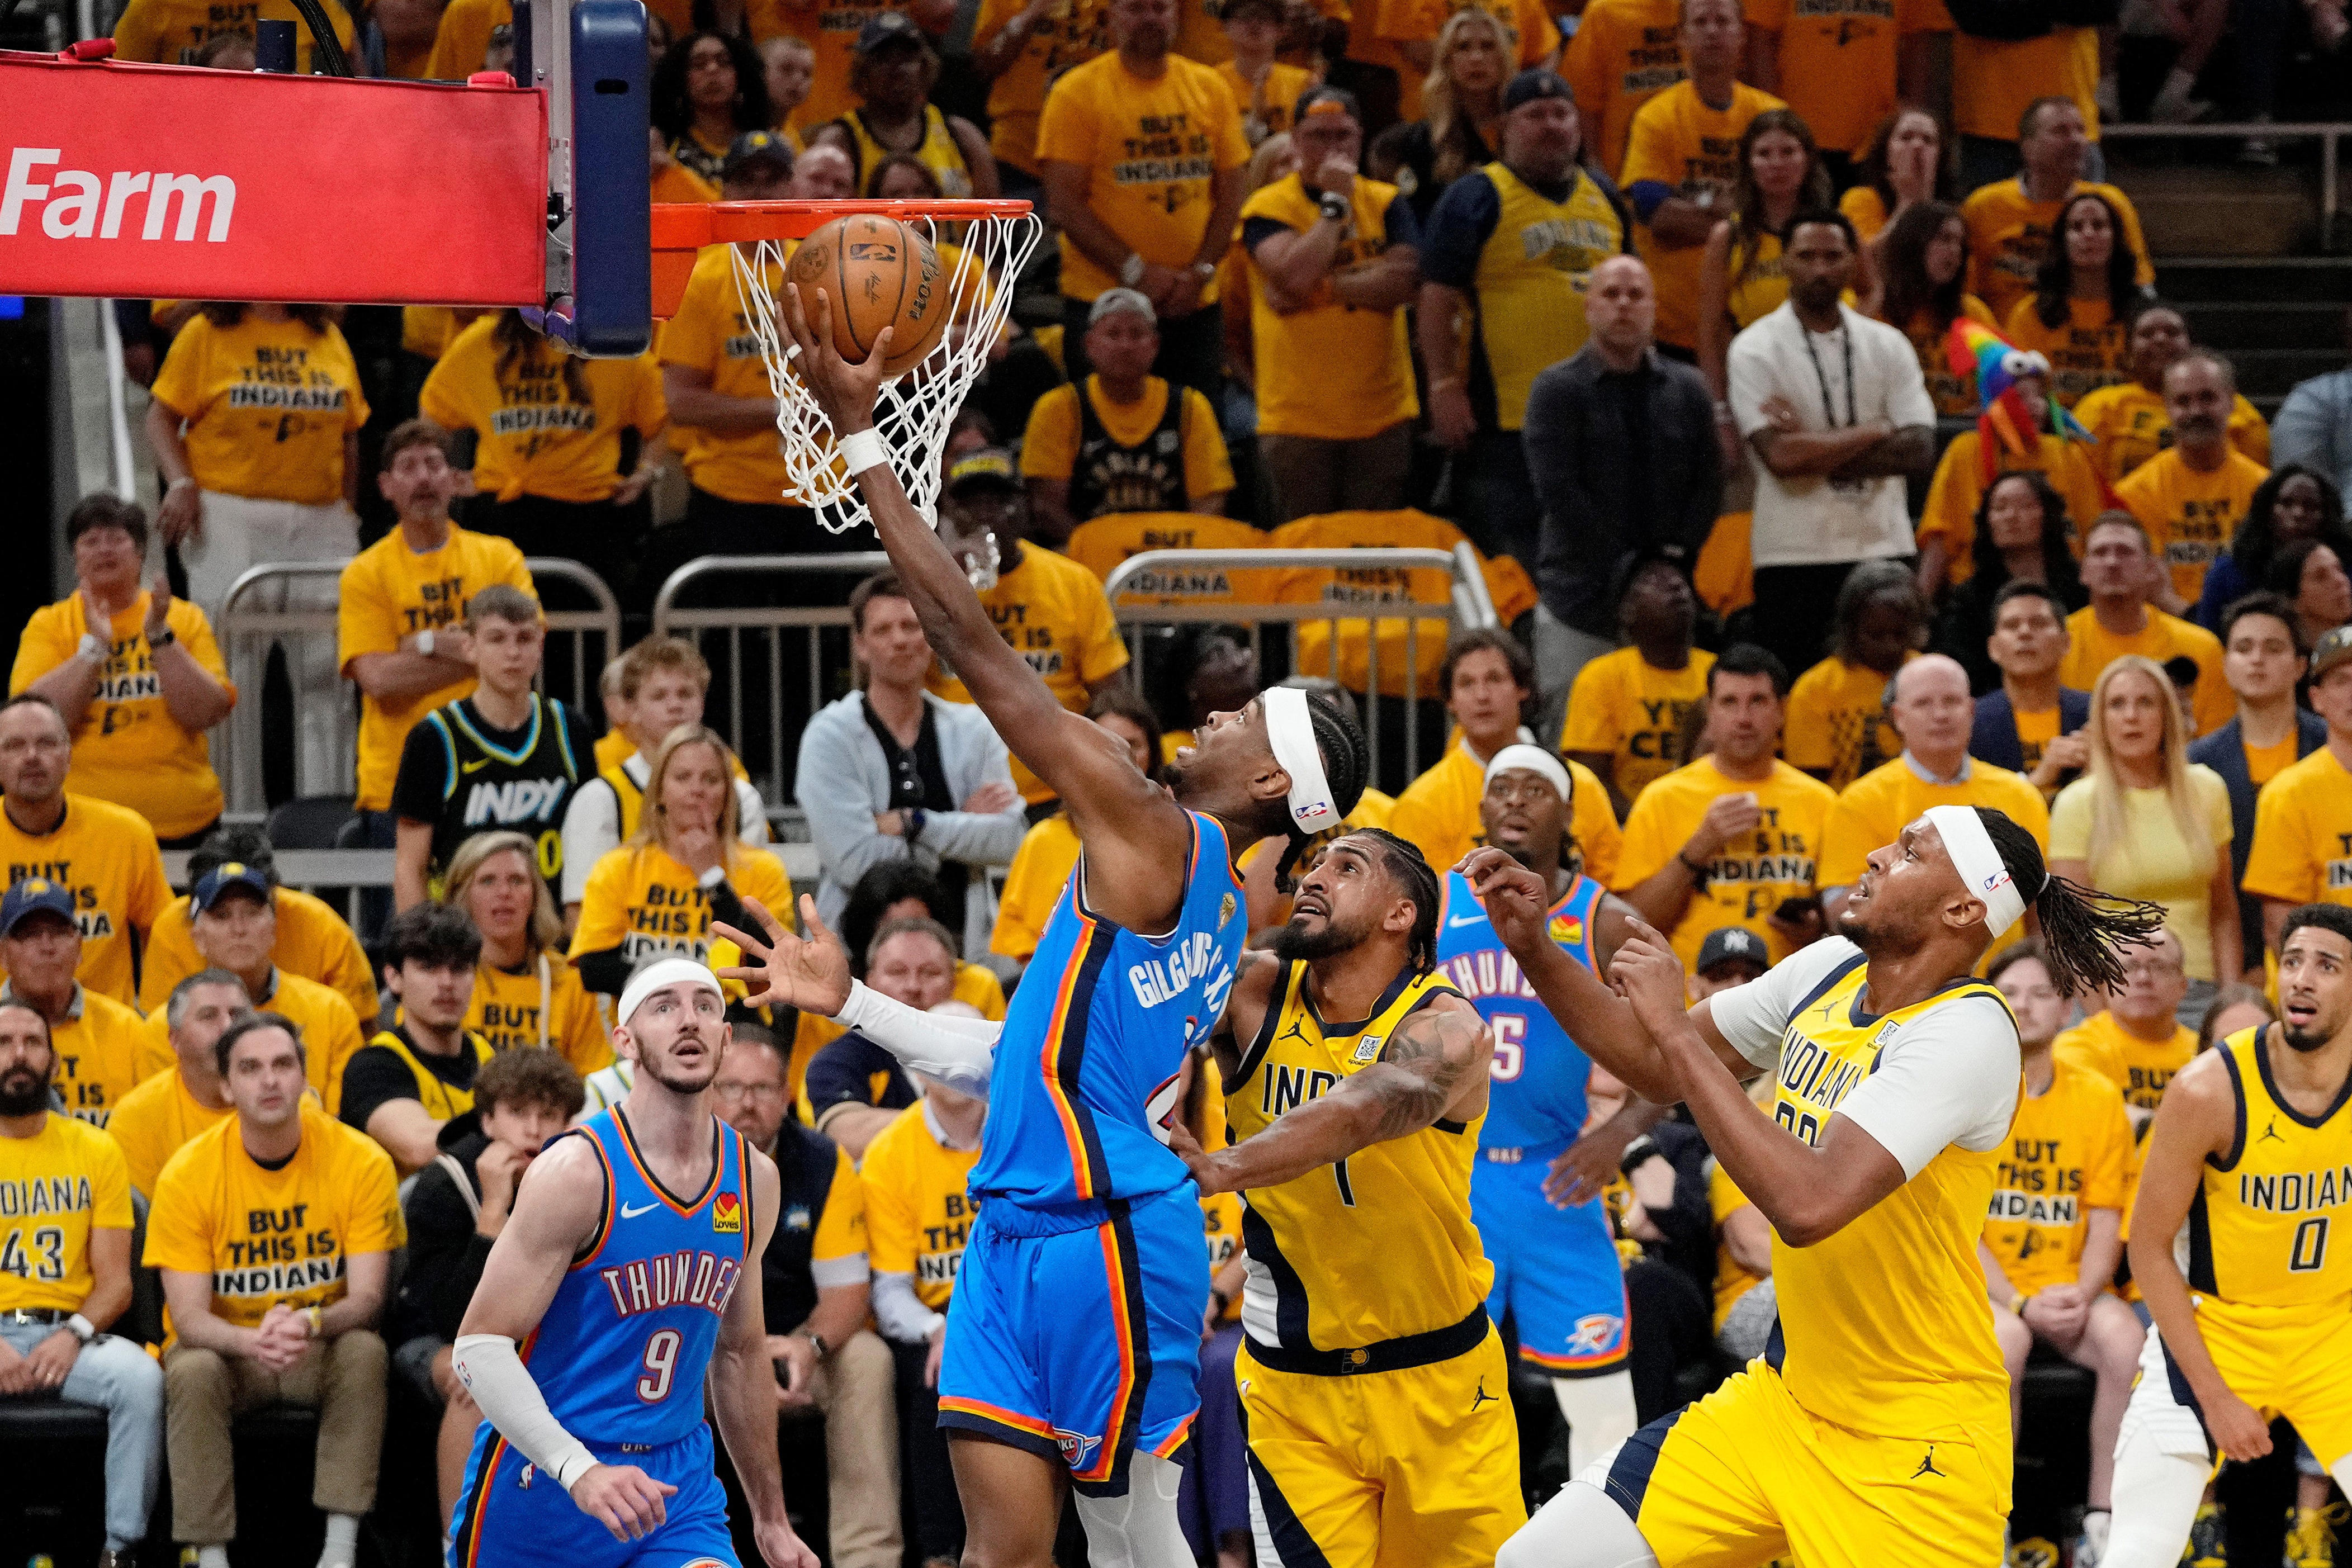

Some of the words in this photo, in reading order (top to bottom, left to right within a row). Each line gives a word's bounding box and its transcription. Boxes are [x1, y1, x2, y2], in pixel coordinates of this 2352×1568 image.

[0, 147, 236, 243] Farm
[256, 345, 309, 364] BUT
[991, 604, 1028, 625] UT
[465, 777, 566, 827] INDY
[1488, 1013, 1526, 1082] 5
[248, 1204, 309, 1233] BUT
[2289, 1216, 2332, 1272] 0
[0, 1226, 64, 1279] 43
[229, 1238, 296, 1266] THIS
[305, 1231, 335, 1256] IS
[636, 1325, 684, 1405] 9
